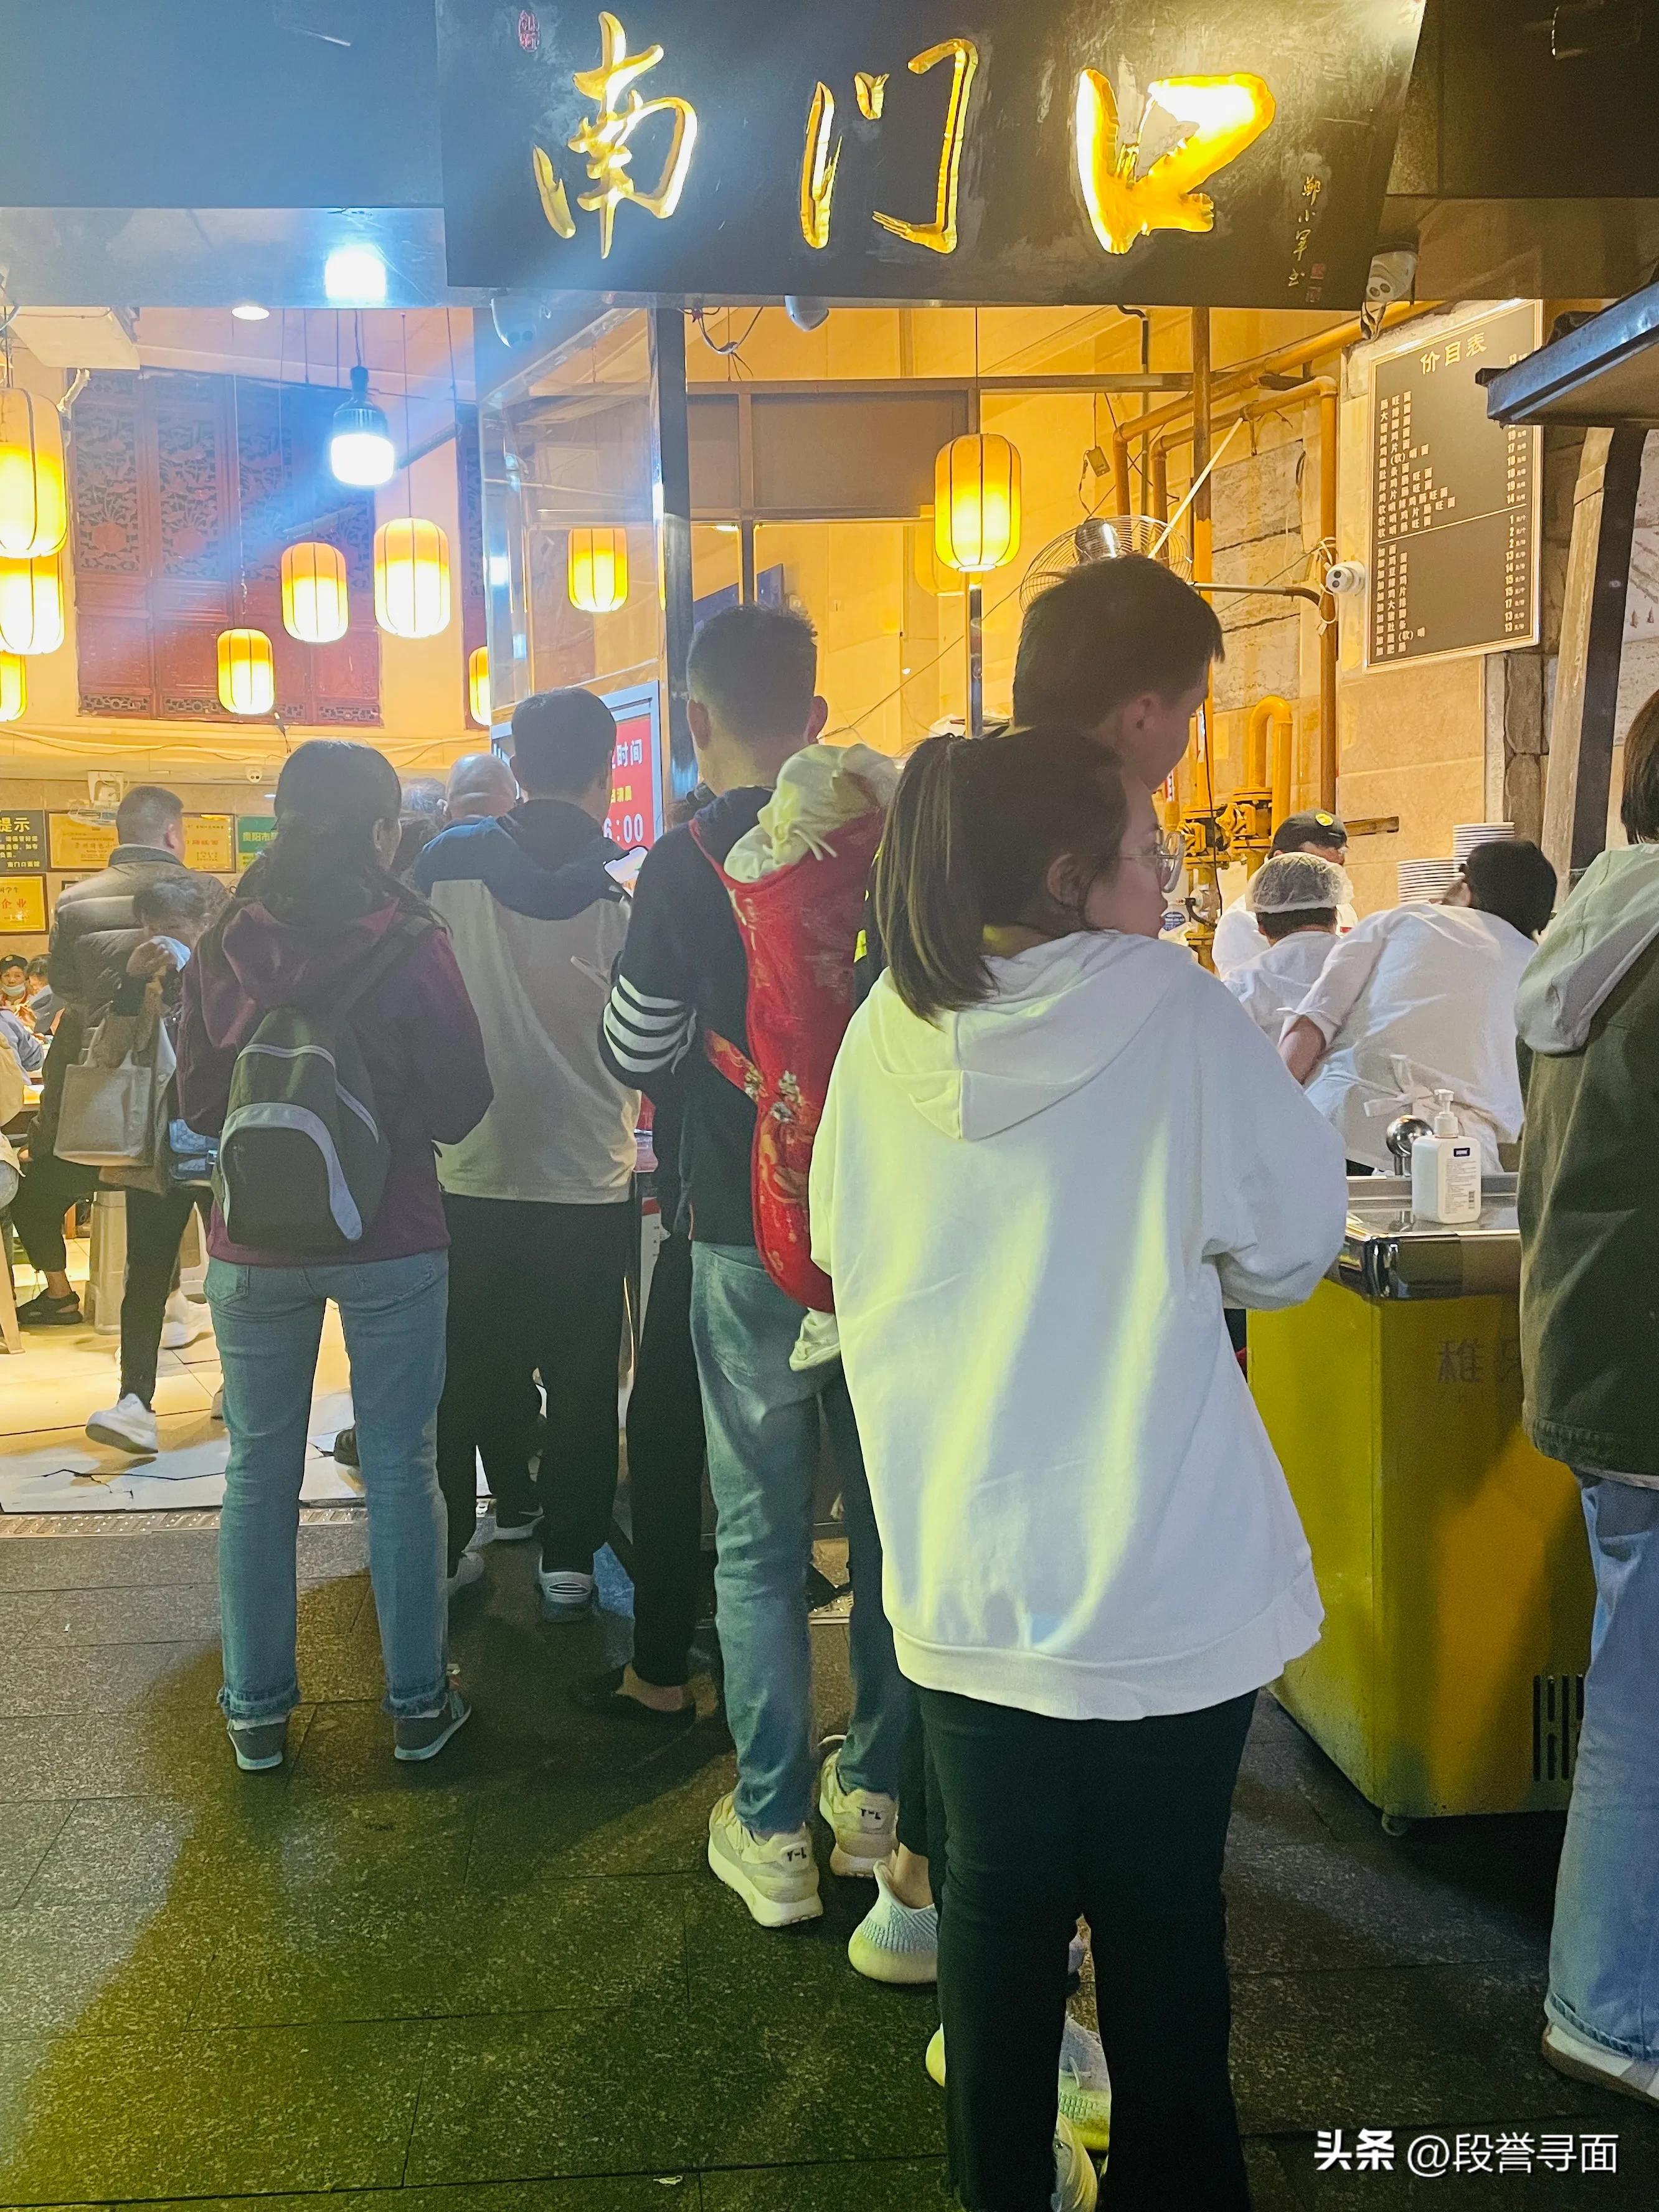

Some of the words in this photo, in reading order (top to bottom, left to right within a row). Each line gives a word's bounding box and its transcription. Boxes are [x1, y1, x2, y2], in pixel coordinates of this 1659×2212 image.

[532, 11, 1275, 255] 南门口
[1420, 333, 1487, 374] 价目表
[1510, 527, 1515, 537] 2
[1510, 539, 1514, 549] 2
[612, 739, 642, 769] 时间
